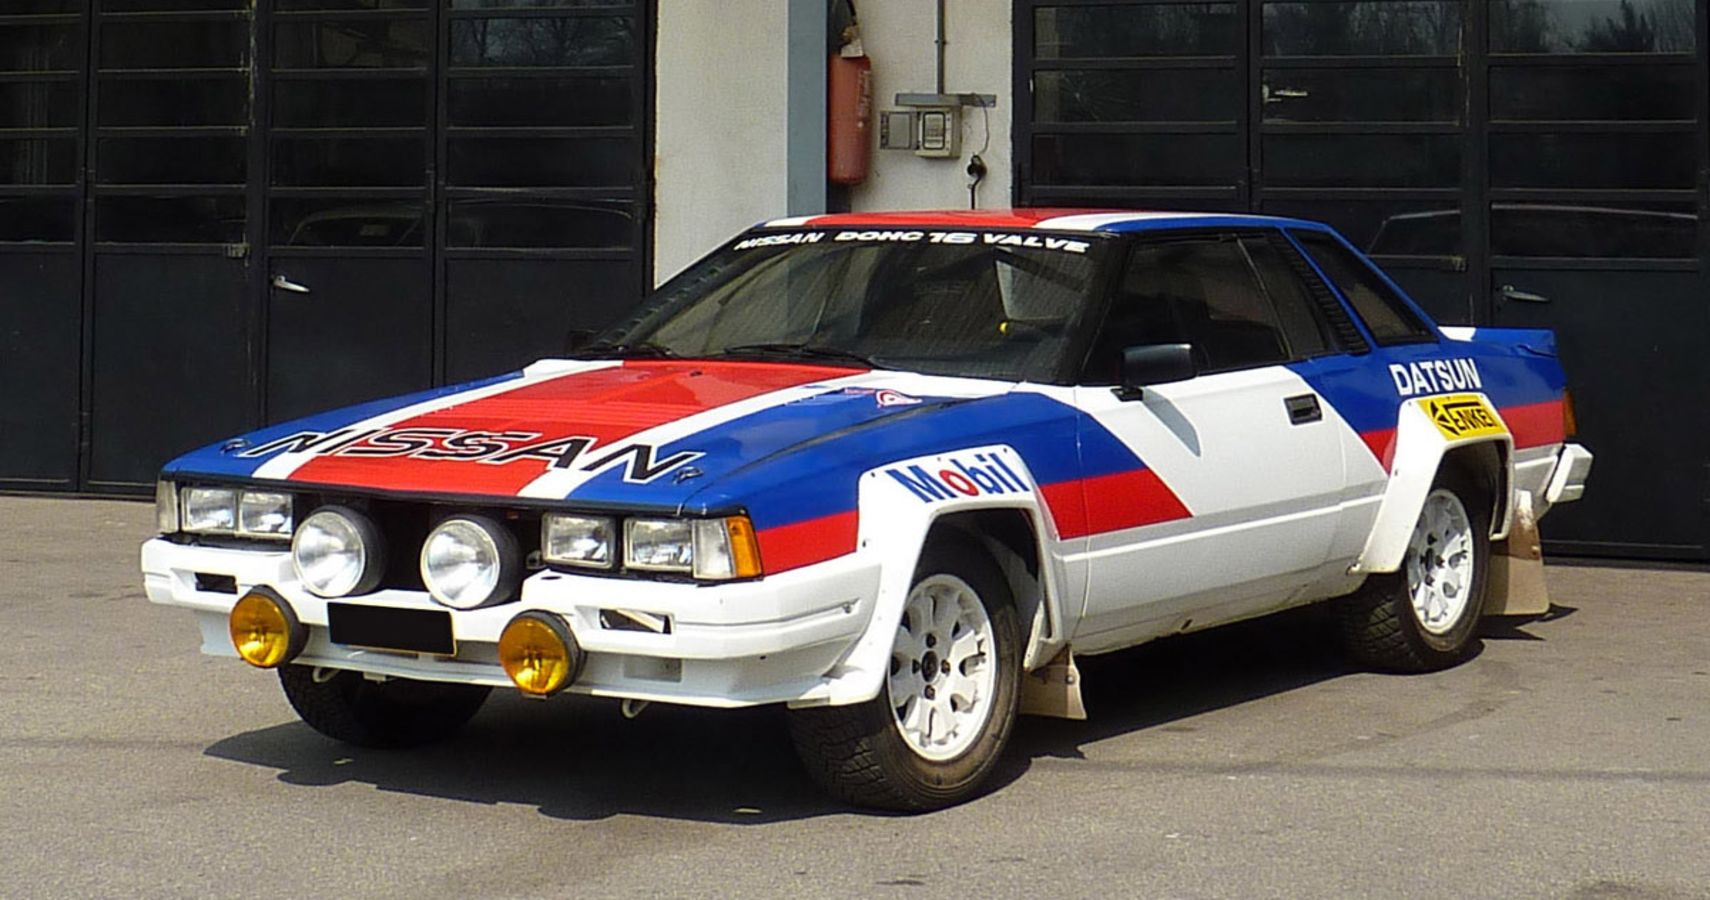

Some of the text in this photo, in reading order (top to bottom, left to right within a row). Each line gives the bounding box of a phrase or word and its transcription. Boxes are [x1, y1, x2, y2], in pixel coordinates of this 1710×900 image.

[734, 232, 825, 250] NISSAN
[928, 232, 977, 244] 16
[983, 233, 1090, 253] VALVE
[1388, 358, 1482, 396] DATSUN
[240, 427, 706, 485] NISSAN
[885, 453, 1030, 503] Mobil
